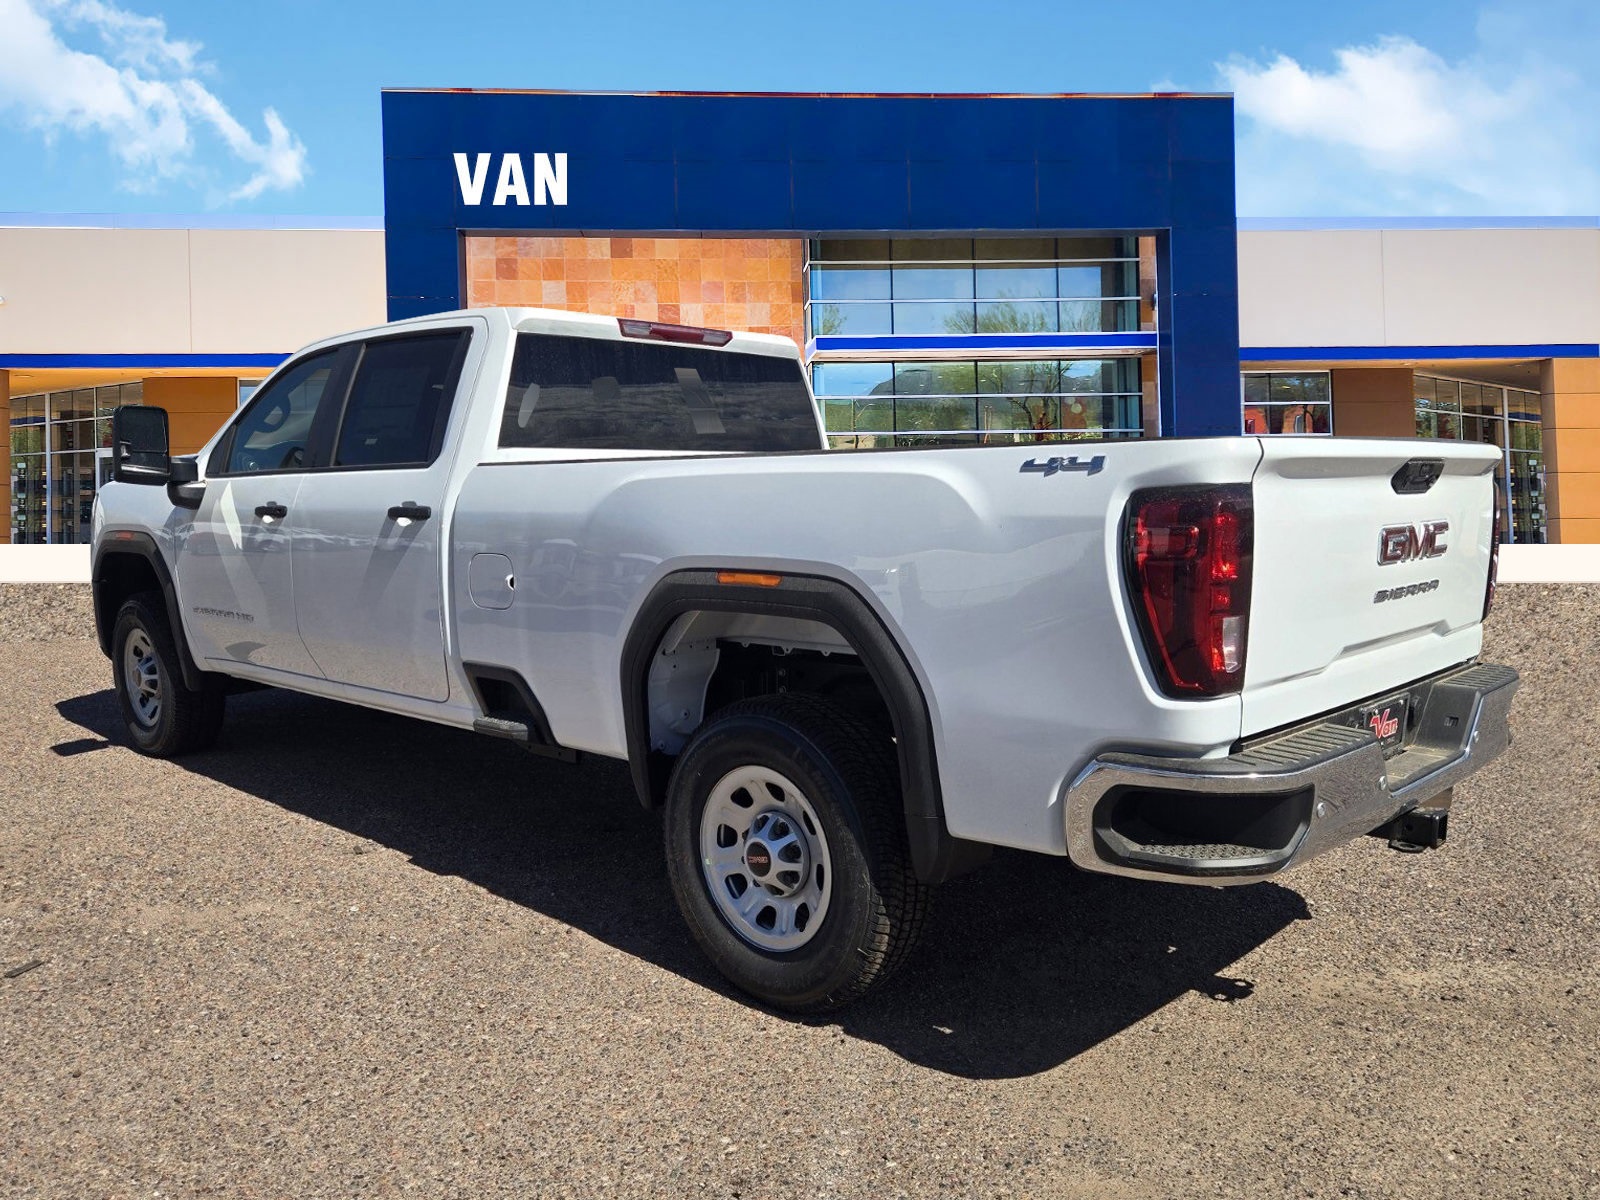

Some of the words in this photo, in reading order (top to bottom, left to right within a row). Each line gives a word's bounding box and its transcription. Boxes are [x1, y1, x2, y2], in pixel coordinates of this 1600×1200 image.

[453, 153, 567, 205] VAN
[1377, 519, 1449, 566] GMC
[1374, 579, 1440, 604] SIERRA
[1370, 708, 1398, 738] Van
